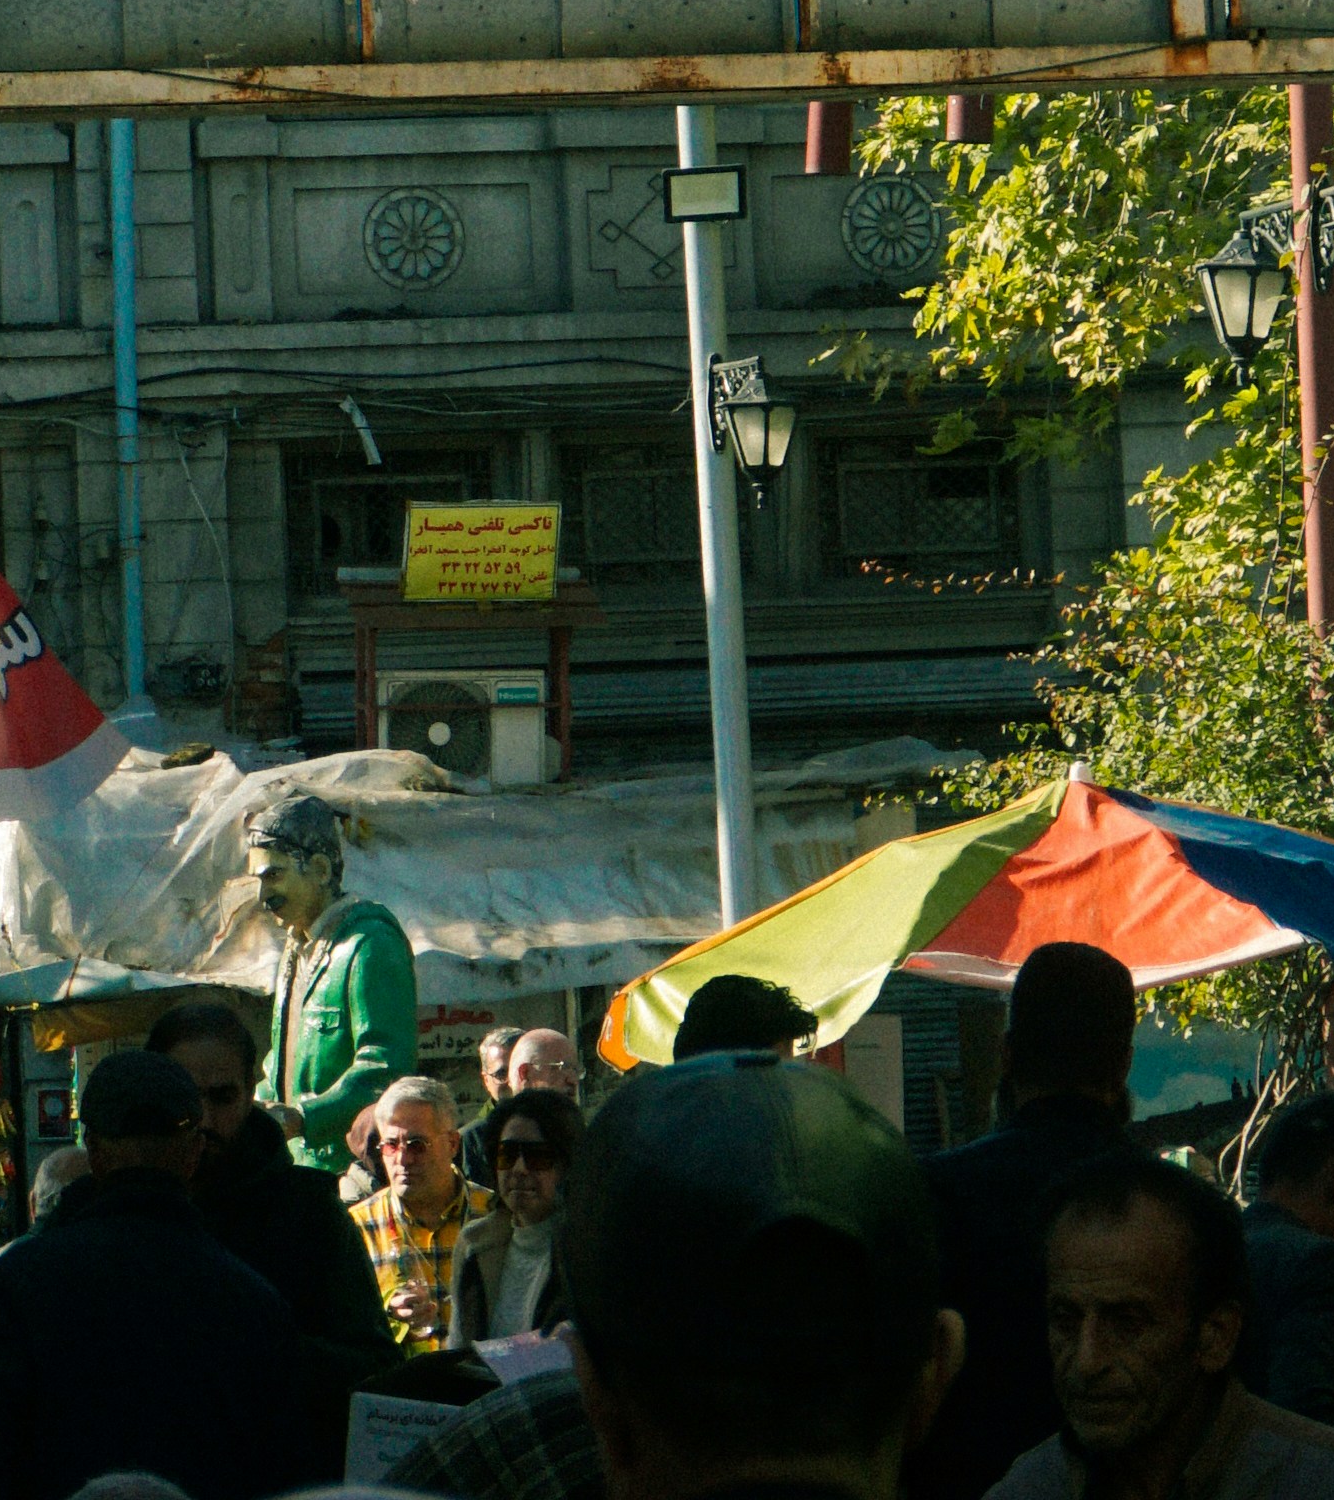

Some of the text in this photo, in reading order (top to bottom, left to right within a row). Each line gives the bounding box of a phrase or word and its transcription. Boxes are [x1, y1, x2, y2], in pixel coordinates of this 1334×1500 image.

[468, 516, 505, 536] تلفنی
[508, 516, 553, 535] تاکسی
[435, 546, 459, 555] مسجد
[461, 545, 480, 556] جنب
[509, 545, 532, 556] کوچه
[533, 544, 555, 556] داخل
